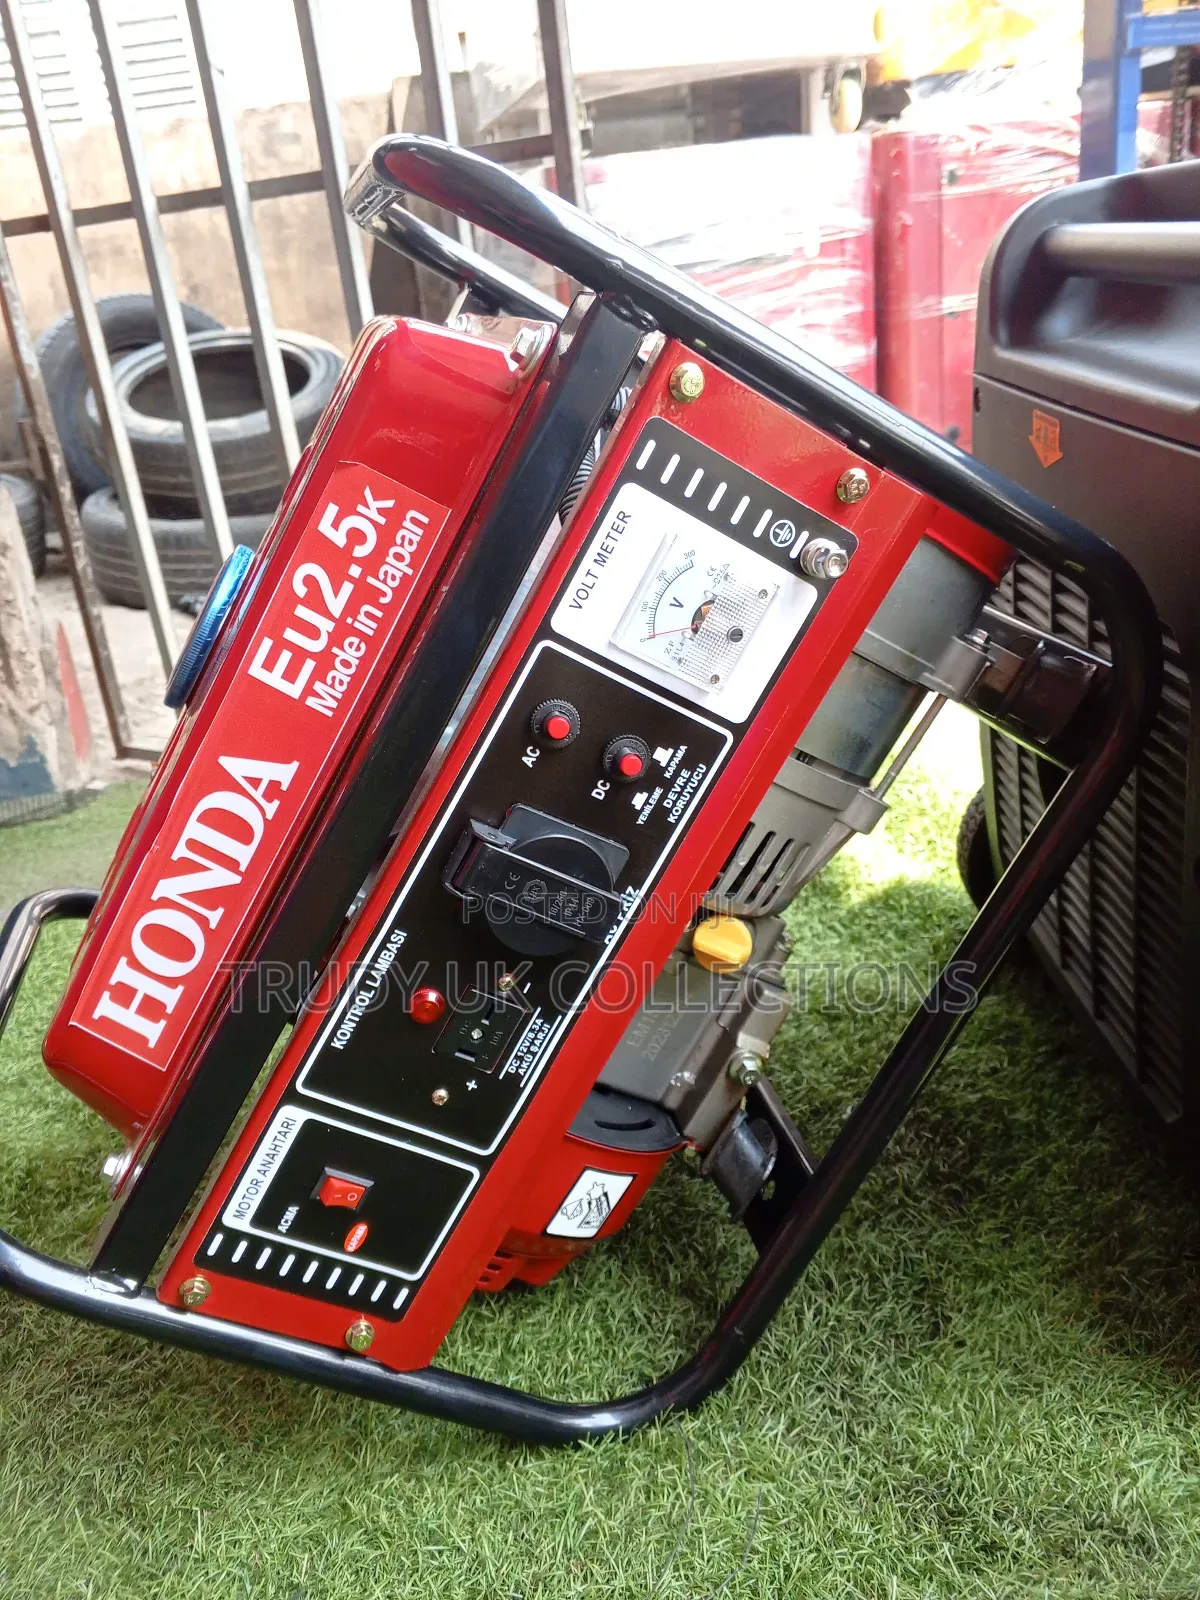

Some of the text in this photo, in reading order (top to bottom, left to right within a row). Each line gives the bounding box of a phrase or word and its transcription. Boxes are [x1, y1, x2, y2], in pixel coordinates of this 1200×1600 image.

[568, 509, 632, 611] VOLT METER
[683, 549, 696, 560] 300
[655, 569, 668, 582] 200
[305, 509, 430, 718] Made in Japan
[640, 601, 649, 613] 100
[669, 596, 684, 609] V
[521, 745, 541, 769] AC
[664, 745, 688, 779] KAPAMA
[591, 779, 611, 801] DC
[662, 768, 692, 809] DEVRE
[666, 763, 708, 825] KORUYUCU
[92, 754, 300, 1049] HONDA
[330, 929, 408, 1051] KONTROL LAMBASI
[507, 1017, 544, 1075] DC 12V/8.3A
[232, 1116, 298, 1221] MOTOR ANAHTARI
